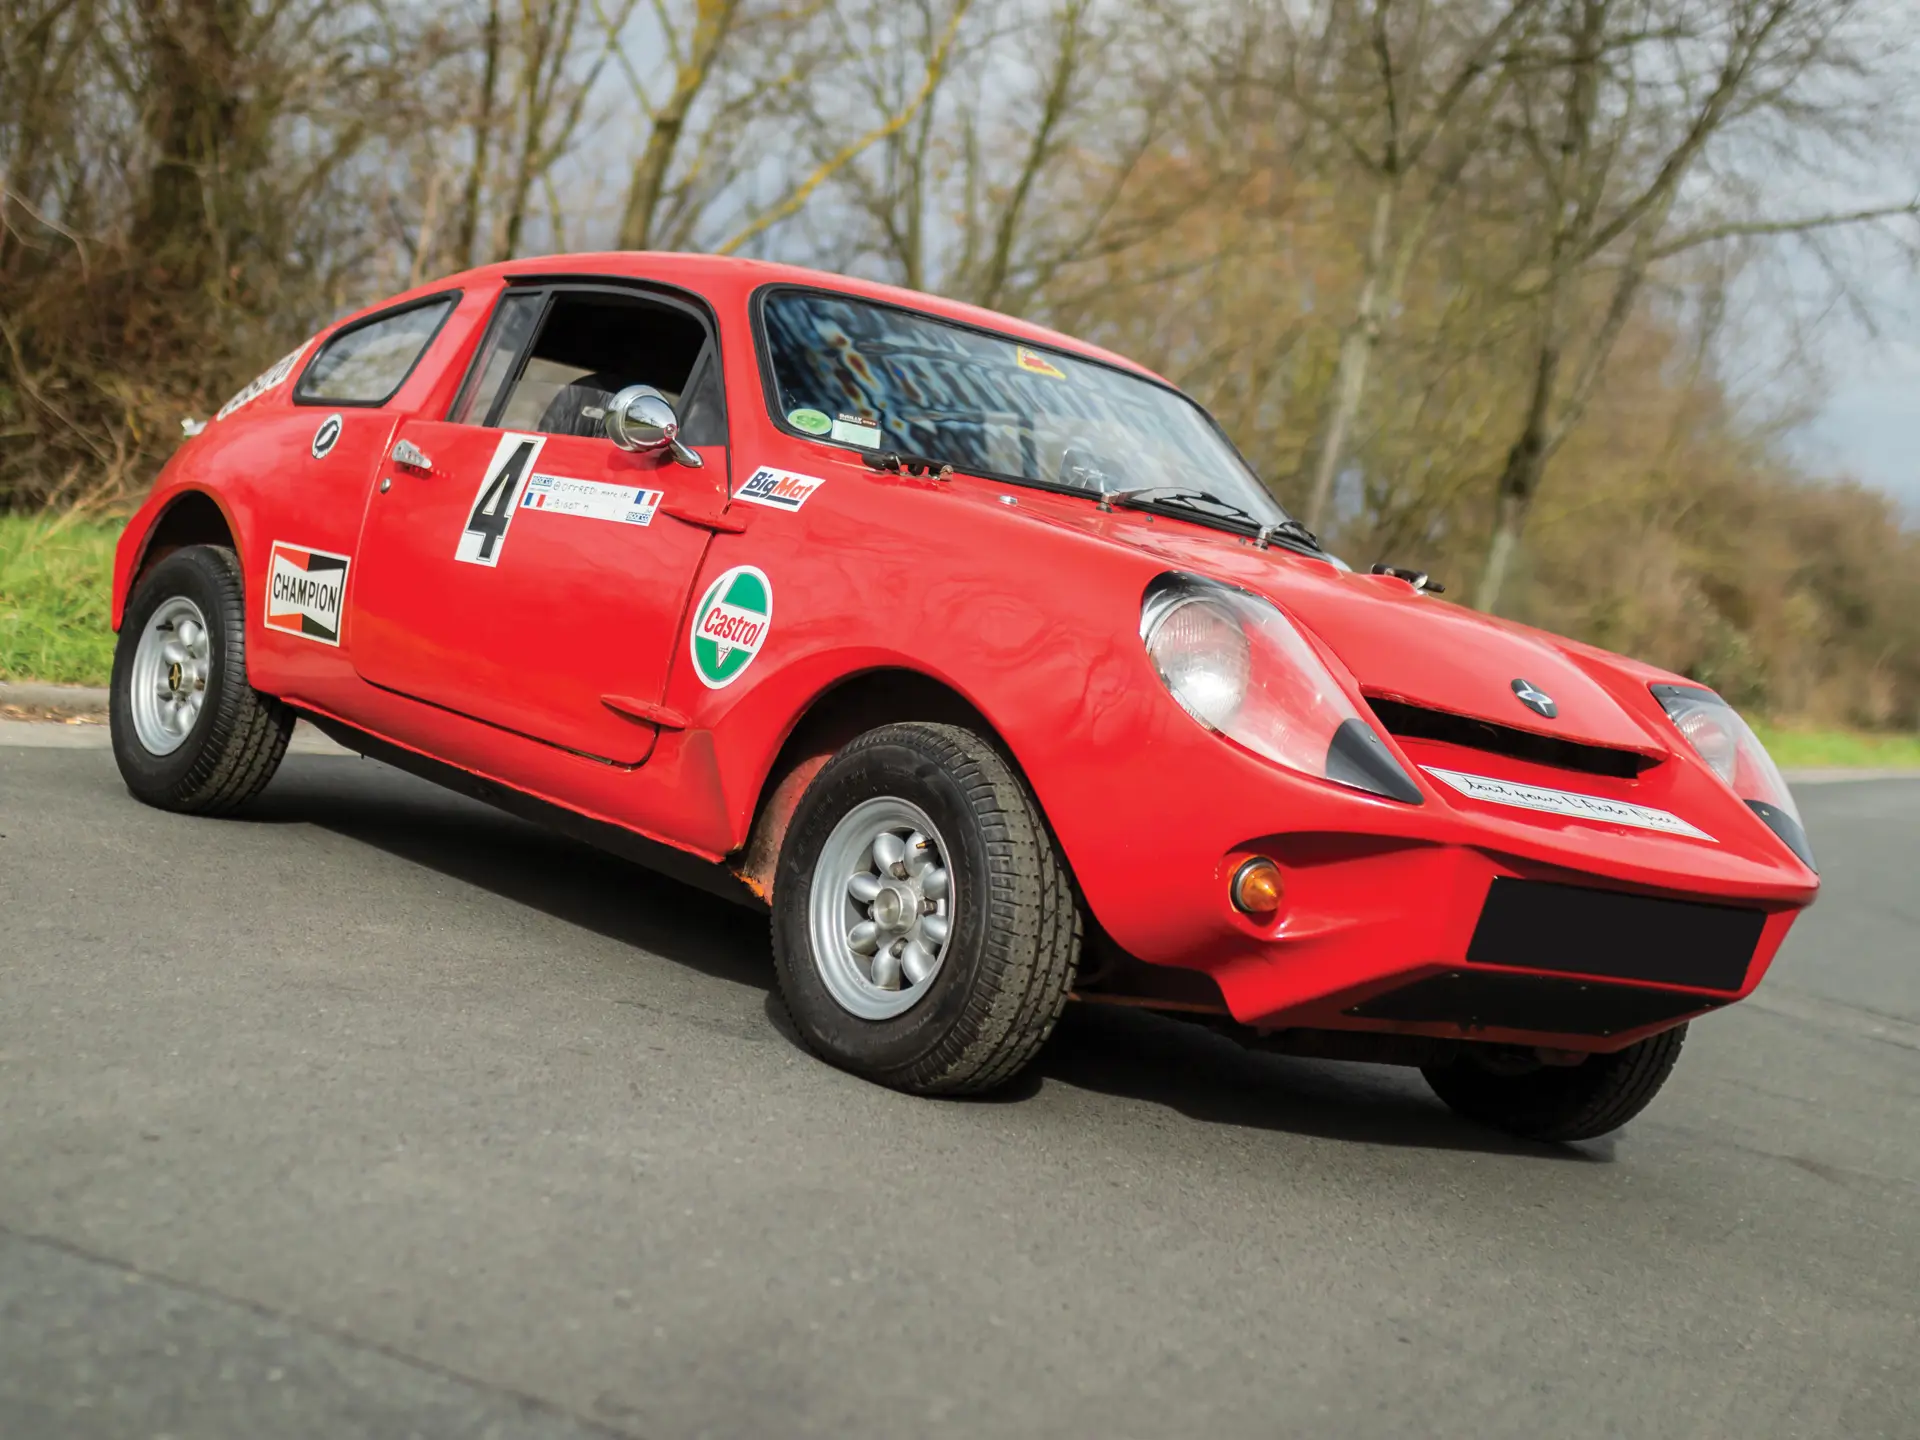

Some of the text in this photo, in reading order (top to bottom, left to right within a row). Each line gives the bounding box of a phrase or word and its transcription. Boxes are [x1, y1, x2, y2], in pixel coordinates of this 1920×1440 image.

[466, 439, 538, 562] 4
[745, 471, 814, 499] BigMat
[273, 572, 338, 613] CHAMPION
[704, 607, 765, 647] Castrol
